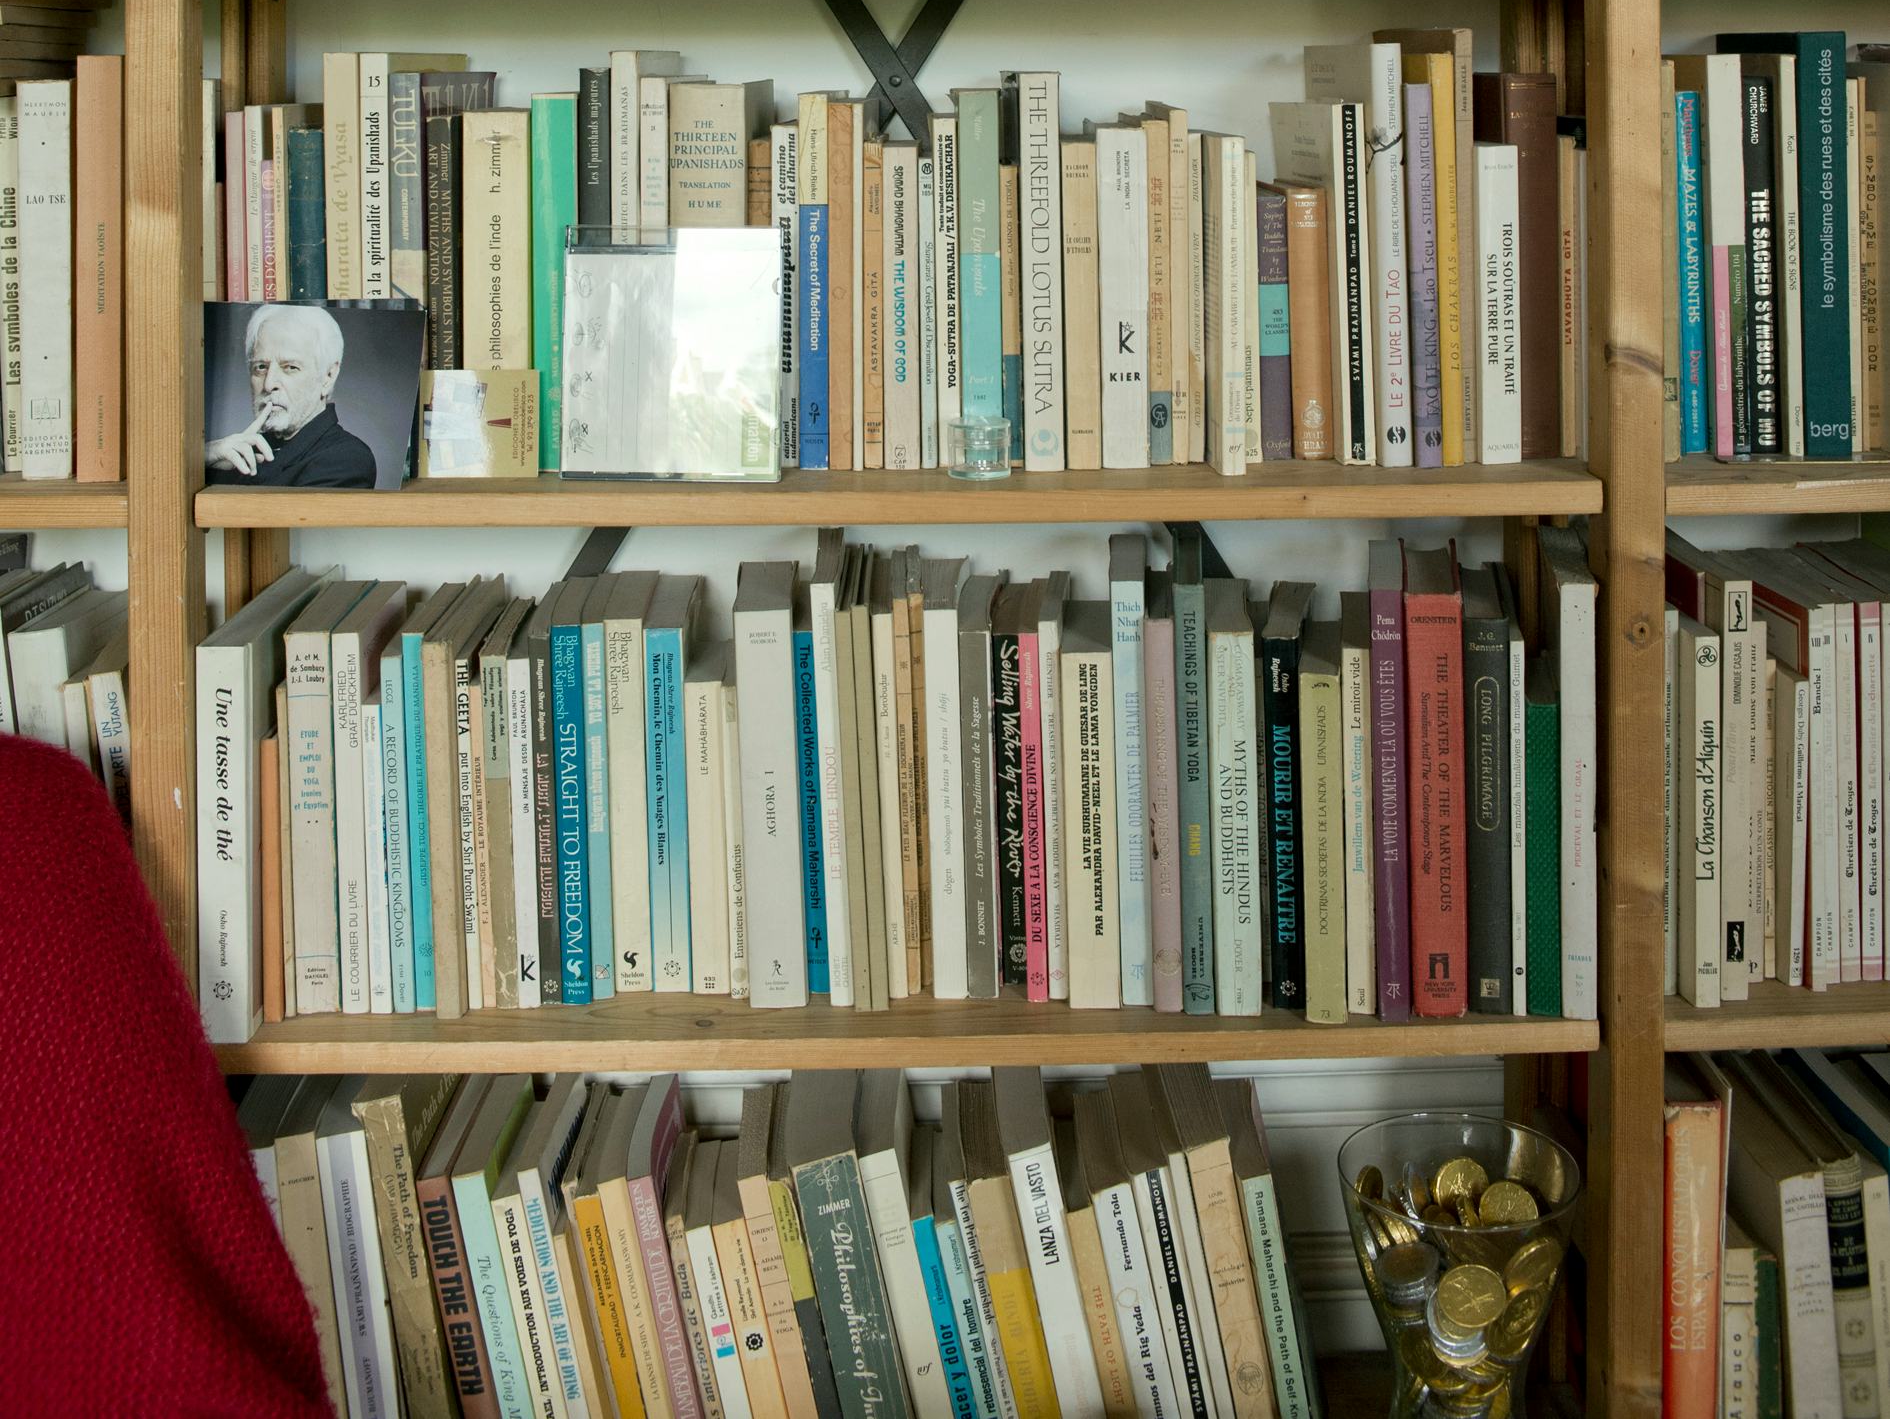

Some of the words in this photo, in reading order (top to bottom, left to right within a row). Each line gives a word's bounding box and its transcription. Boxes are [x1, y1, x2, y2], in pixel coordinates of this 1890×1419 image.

[1818, 50, 1832, 84] cités
[1028, 81, 1046, 123] THE
[1818, 88, 1831, 115] des
[366, 112, 382, 173] Upanishads
[392, 89, 418, 177] TULKU
[674, 132, 737, 141] THIRTEEN
[1820, 118, 1831, 134] et
[670, 159, 744, 168] UPANISHADS
[674, 145, 738, 154] PRINCIPAL
[1820, 137, 1832, 169] rues
[26, 195, 43, 204] LAO
[46, 194, 66, 203] TSE
[366, 180, 380, 197] des
[1029, 129, 1050, 253] THREEFOLD
[1819, 173, 1833, 200] des
[688, 200, 722, 208] HUME
[1752, 189, 1770, 222] THE
[366, 205, 383, 265] spiritualité
[488, 214, 502, 250] l'inde
[1819, 203, 1835, 291] symbolisme
[367, 272, 382, 282] la
[488, 254, 502, 272] de
[1753, 228, 1772, 295] SACRED
[1032, 261, 1052, 332] LOTUS
[1447, 255, 1459, 332] CHAKRAS
[1820, 295, 1834, 307] le
[488, 275, 503, 360] philosophies
[1450, 339, 1460, 370] LOS
[1755, 301, 1774, 384] SYMBOLS
[1033, 340, 1053, 414] SUTRA
[1109, 372, 1141, 382] KIER
[1758, 389, 1775, 412] OF
[1758, 418, 1776, 446] MU
[1810, 421, 1849, 438] berg
[1350, 657, 1361, 679] vide
[216, 688, 232, 728] Une
[339, 671, 347, 729] KARLFRIED
[1351, 682, 1362, 714] miroir
[349, 720, 358, 748] GRAF
[1351, 717, 1362, 729] Le
[217, 736, 230, 789] tasse
[1025, 745, 1037, 784] DIVINE
[1273, 724, 1292, 802] MOURIR
[1697, 720, 1720, 785] d'Aiquin
[560, 723, 579, 822] STRAIGHT
[217, 797, 230, 821] de
[766, 785, 777, 837] AGHORA
[1845, 781, 1856, 815] Troyes
[1027, 788, 1039, 860] CONSCIENCE
[1278, 806, 1293, 828] ET
[1696, 788, 1715, 855] Chanson
[1845, 818, 1854, 829] de
[215, 831, 232, 860] thé
[563, 828, 580, 855] TO
[1845, 832, 1855, 878] Chrétien
[696, 861, 1715, 880] La
[1029, 864, 1040, 879] LA
[1278, 833, 1296, 943] RENAITRE
[565, 860, 583, 953] FREEDOM
[1030, 893, 1041, 923] SEXE
[1031, 927, 1042, 943] DU
[1026, 1163, 1047, 1198] VASTO
[818, 1199, 851, 1215] ZIMMER
[1035, 1202, 1051, 1223] DEL
[1109, 1193, 1123, 1217] Tola
[1254, 1190, 1270, 1235] Ramana
[423, 1194, 458, 1268] TOUCH
[1040, 1226, 1060, 1265] LANZA
[1115, 1219, 1133, 1271] Fernando
[1261, 1239, 1279, 1298] Maharshi
[442, 1271, 461, 1315] THE
[1670, 1316, 1686, 1350] LOS
[449, 1320, 484, 1395] EARTH
